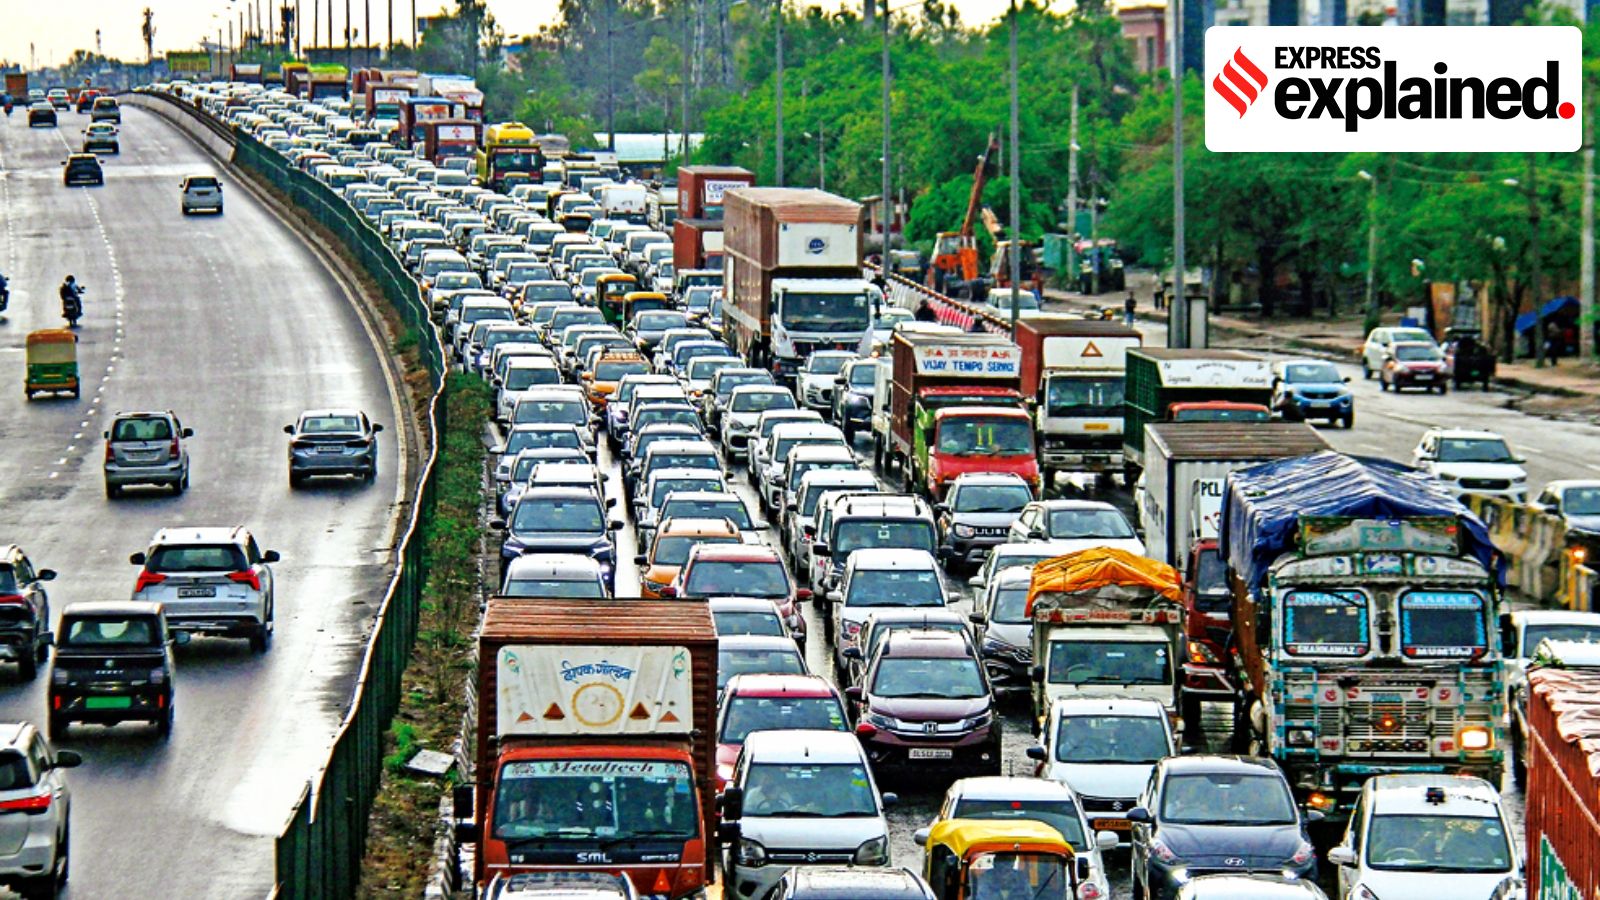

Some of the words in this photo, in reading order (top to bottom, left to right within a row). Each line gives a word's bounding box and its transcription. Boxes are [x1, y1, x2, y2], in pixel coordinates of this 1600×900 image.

[922, 360, 947, 370] VIJAY
[952, 361, 983, 371] TEMPO
[1201, 481, 1221, 497] PCL
[549, 761, 654, 774] Metaltech
[576, 852, 612, 863] SML
